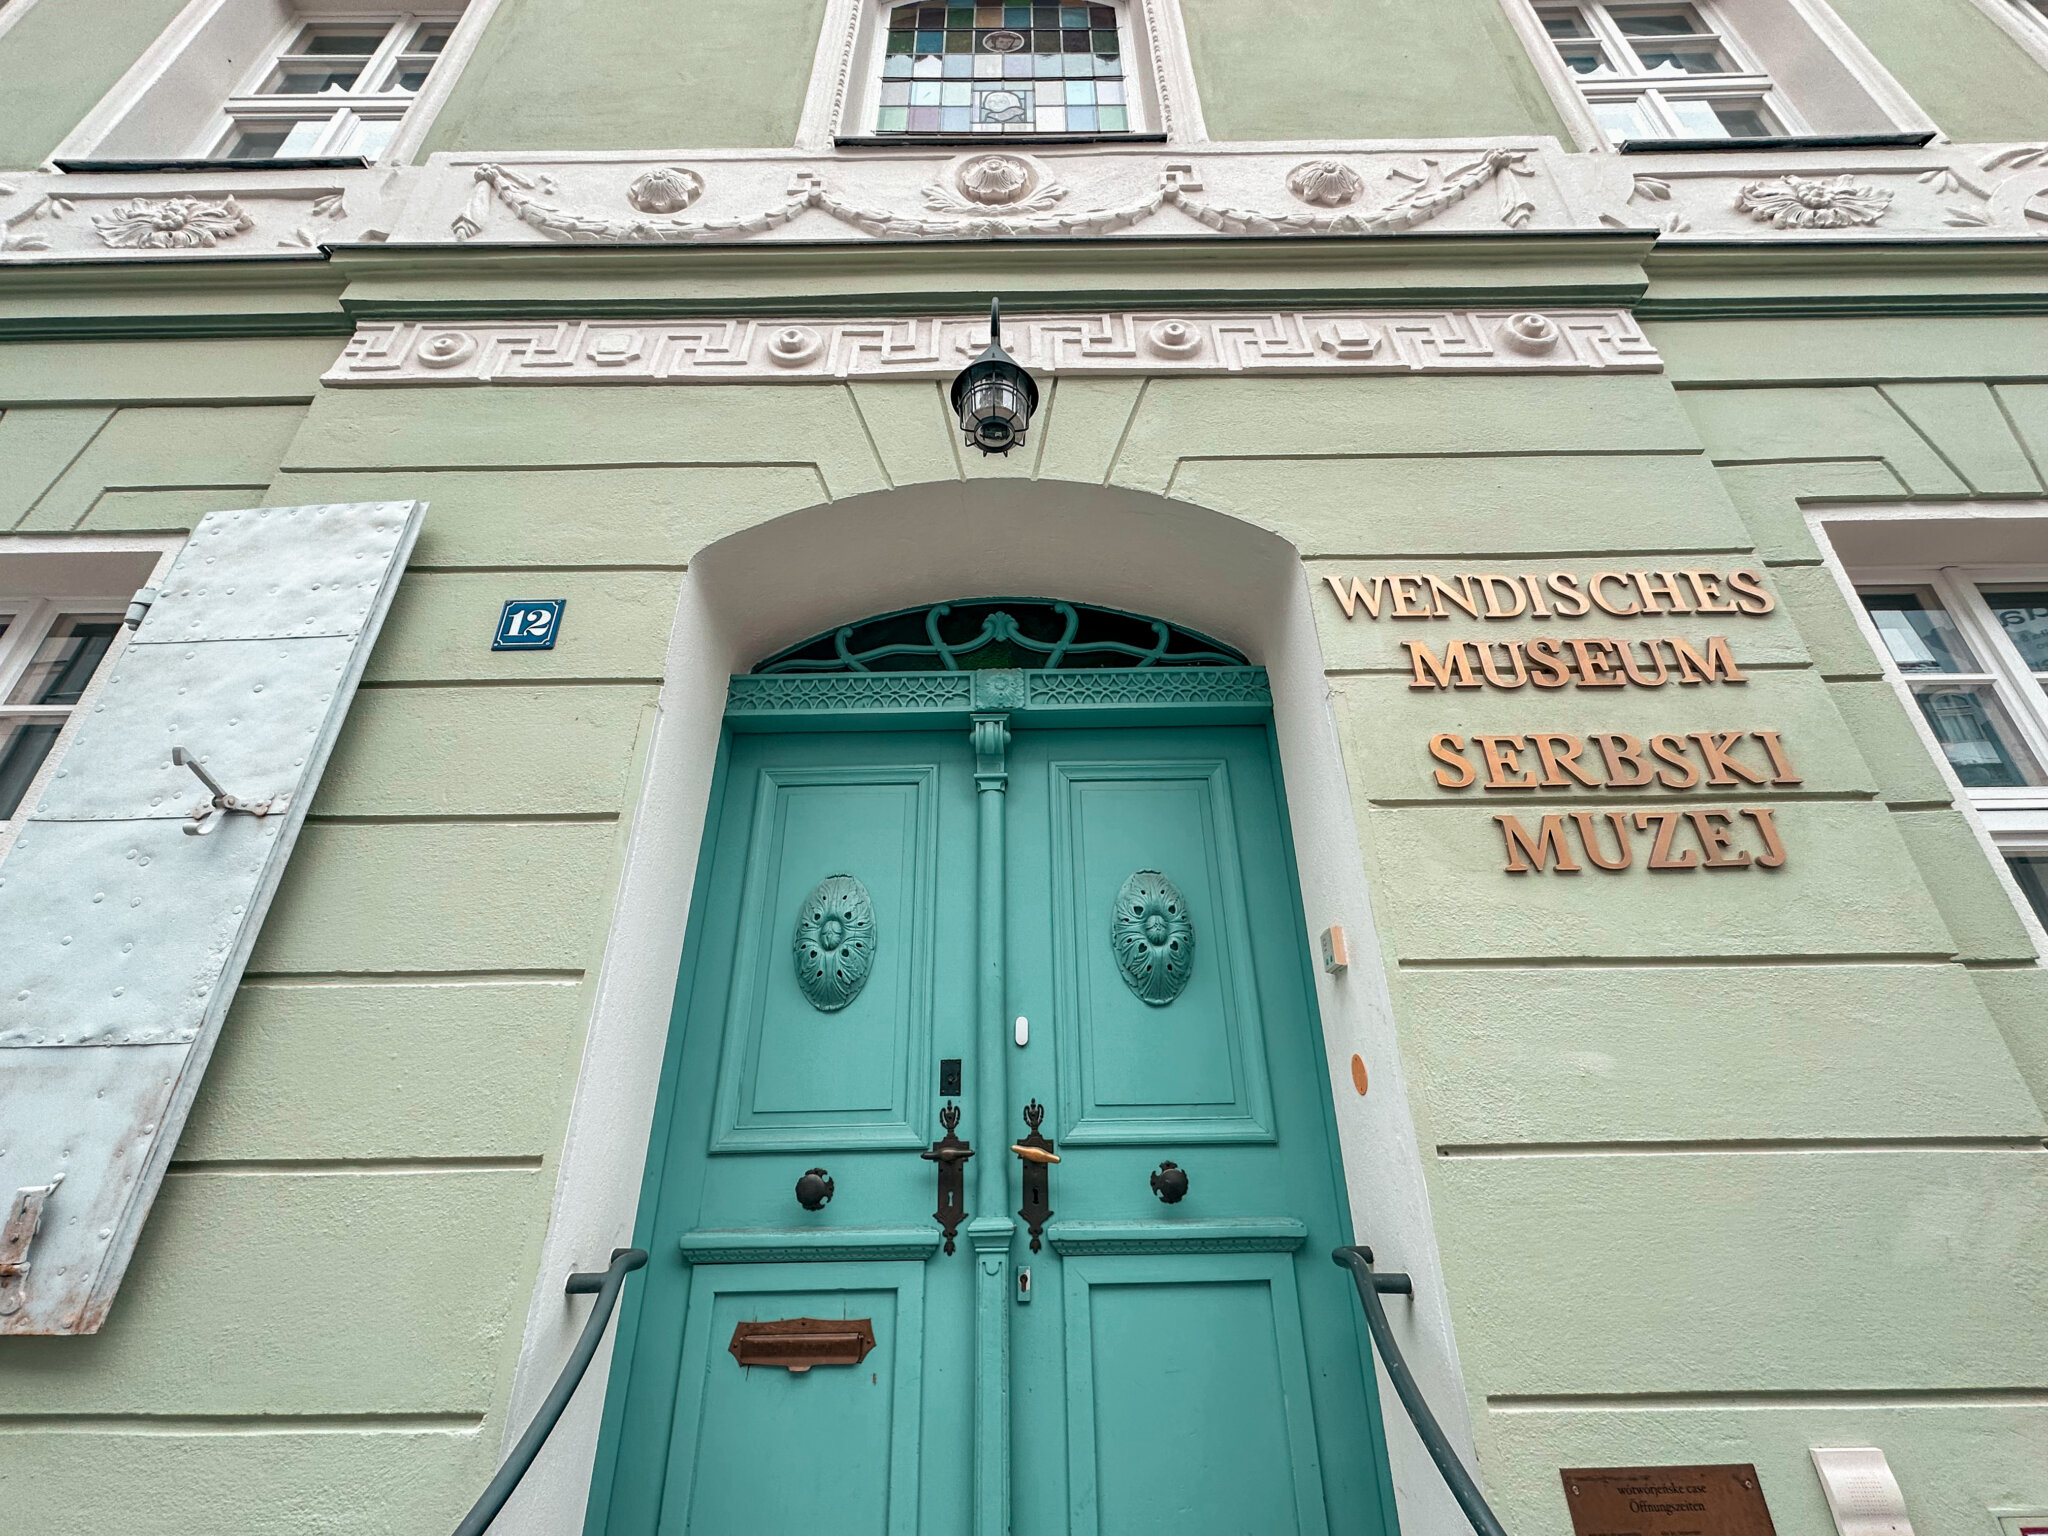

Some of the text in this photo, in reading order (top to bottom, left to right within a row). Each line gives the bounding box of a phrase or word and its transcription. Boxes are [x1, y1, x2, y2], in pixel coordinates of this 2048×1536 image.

[1322, 569, 1776, 620] WENDISCHES
[503, 609, 552, 637] 12
[1401, 635, 1749, 690] MUSEUM
[1428, 731, 1803, 790] SERBSKI
[1493, 808, 1788, 873] MUZEJ
